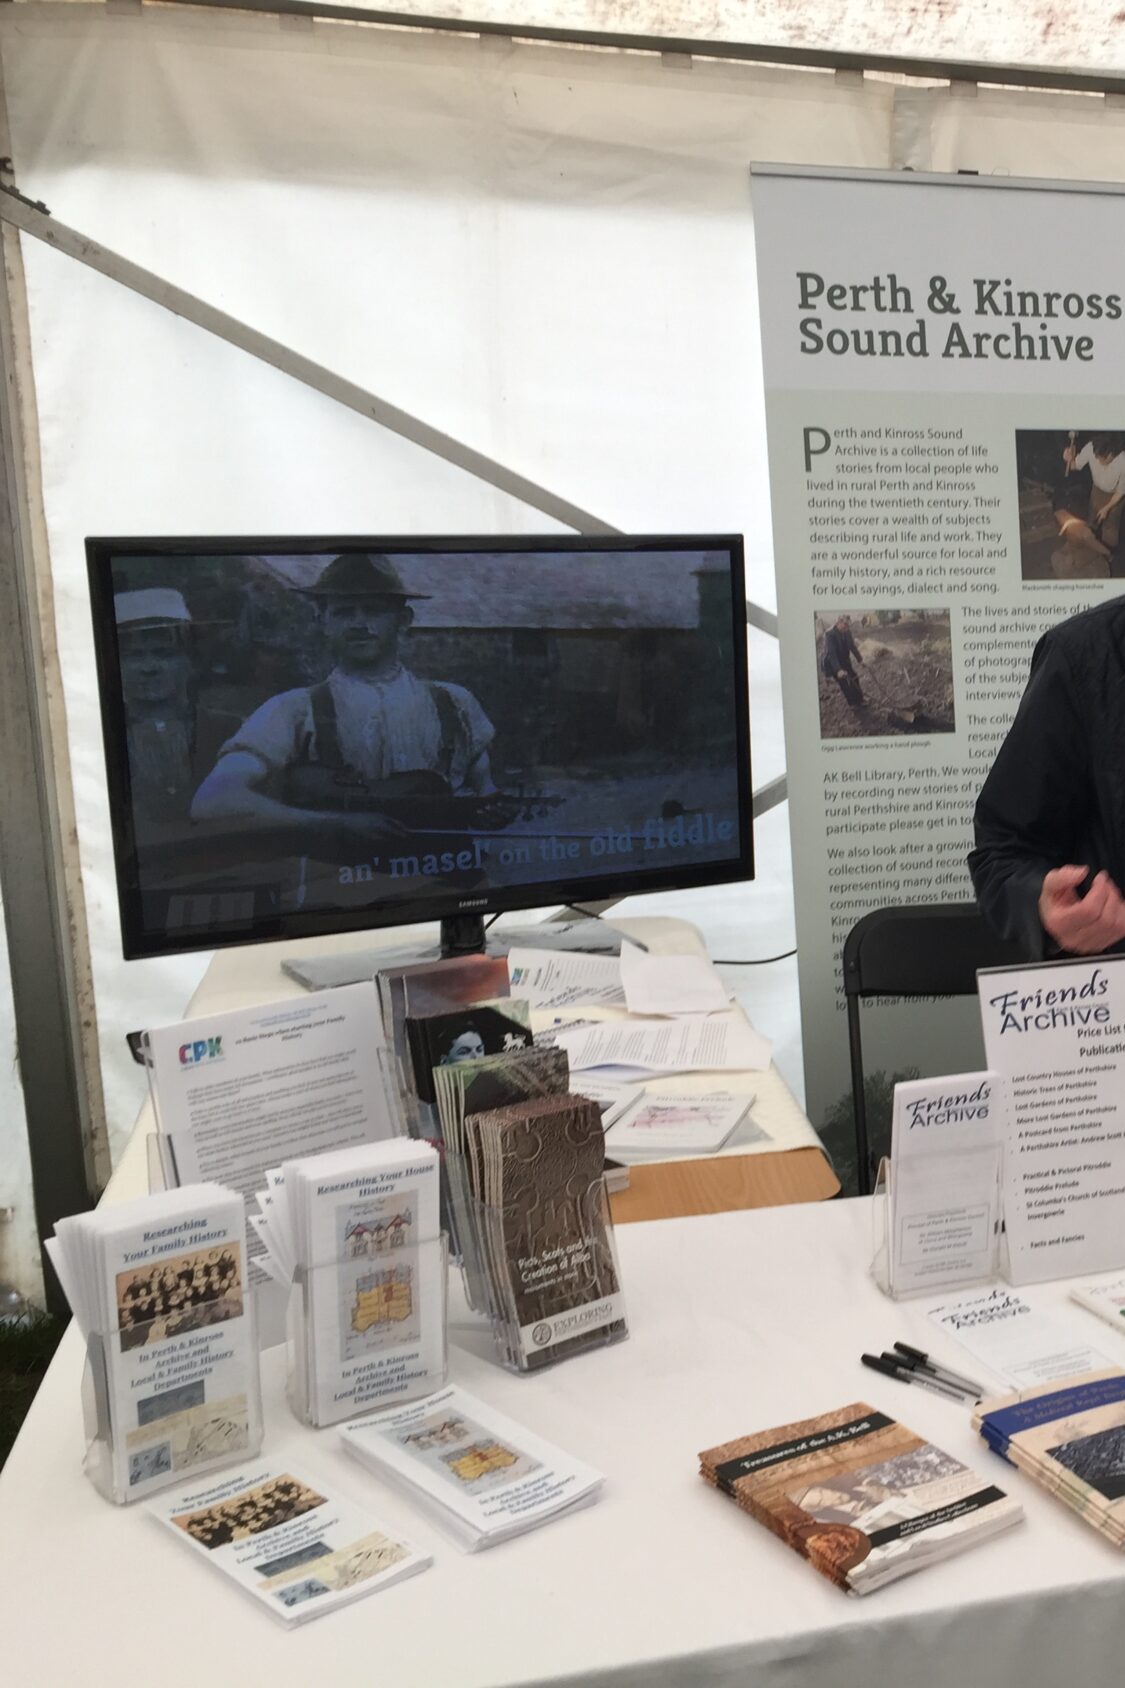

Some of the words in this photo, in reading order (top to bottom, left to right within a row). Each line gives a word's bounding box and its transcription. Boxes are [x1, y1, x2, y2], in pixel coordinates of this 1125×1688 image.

[796, 272, 914, 313] Perth
[927, 276, 961, 315] &
[974, 279, 1123, 320] Kinross
[799, 318, 929, 358] Sound
[942, 322, 1094, 361] Archive
[860, 428, 881, 438] and
[885, 428, 924, 438] Kinross
[927, 428, 962, 439] Sound
[835, 445, 877, 455] Archive
[880, 446, 888, 456] is
[891, 448, 898, 456] a
[901, 445, 954, 456] collection
[957, 445, 968, 456] of
[971, 445, 988, 456] life
[835, 463, 872, 473] stories
[875, 462, 902, 473] from
[905, 462, 930, 473] local
[933, 463, 972, 475] people
[974, 463, 998, 473] who
[807, 479, 834, 490] lived
[837, 480, 847, 490] in
[851, 480, 876, 490] rural
[880, 480, 909, 490] Perth
[912, 480, 933, 490] and
[936, 480, 976, 490] Kinross
[807, 497, 845, 510] during
[848, 497, 867, 508] the
[870, 497, 924, 507] twentieth
[975, 496, 1000, 507] Their
[809, 516, 846, 525] stories
[849, 517, 879, 525] cover
[882, 517, 888, 525] a
[892, 514, 928, 525] wealth
[931, 513, 942, 524] of
[945, 514, 990, 526] subjects
[810, 532, 869, 545] describing
[872, 531, 898, 542] rural
[900, 531, 917, 542] life
[920, 531, 940, 542] and
[977, 530, 1002, 543] They
[810, 552, 828, 560] are
[831, 552, 837, 560] a
[840, 548, 898, 560] wonderful
[902, 551, 937, 559] source
[940, 548, 955, 559] for
[958, 547, 984, 558] local
[986, 547, 1007, 558] and
[811, 566, 846, 580] family
[849, 566, 890, 579] history,
[893, 565, 914, 576] and
[916, 568, 923, 576] a
[926, 565, 946, 575] rich
[949, 567, 996, 575] resource
[812, 584, 828, 595] for
[831, 584, 857, 595] local
[860, 584, 904, 596] sayings,
[907, 582, 943, 593] dialect
[946, 581, 967, 592] and
[961, 606, 982, 616] The
[985, 606, 1008, 616] lives
[1011, 605, 1030, 615] and
[1033, 606, 1067, 614] stories
[968, 748, 996, 759] Local
[823, 772, 838, 782] AK
[841, 770, 861, 782] Bell
[941, 766, 958, 776] We
[841, 787, 894, 799] recording
[897, 787, 920, 795] new
[923, 784, 958, 794] stories
[825, 805, 850, 817] rural
[854, 802, 909, 814] Perthshire
[912, 800, 932, 811] and
[500, 843, 532, 865] on
[540, 836, 581, 861] the
[590, 829, 632, 856] old
[642, 814, 735, 851] fiddle
[990, 969, 1109, 1015] Friends
[1000, 1006, 1111, 1035] Archive
[1077, 1027, 1102, 1038] Price
[1104, 1024, 1121, 1035] List
[906, 1081, 992, 1116] Friends
[910, 1106, 990, 1130] Archive
